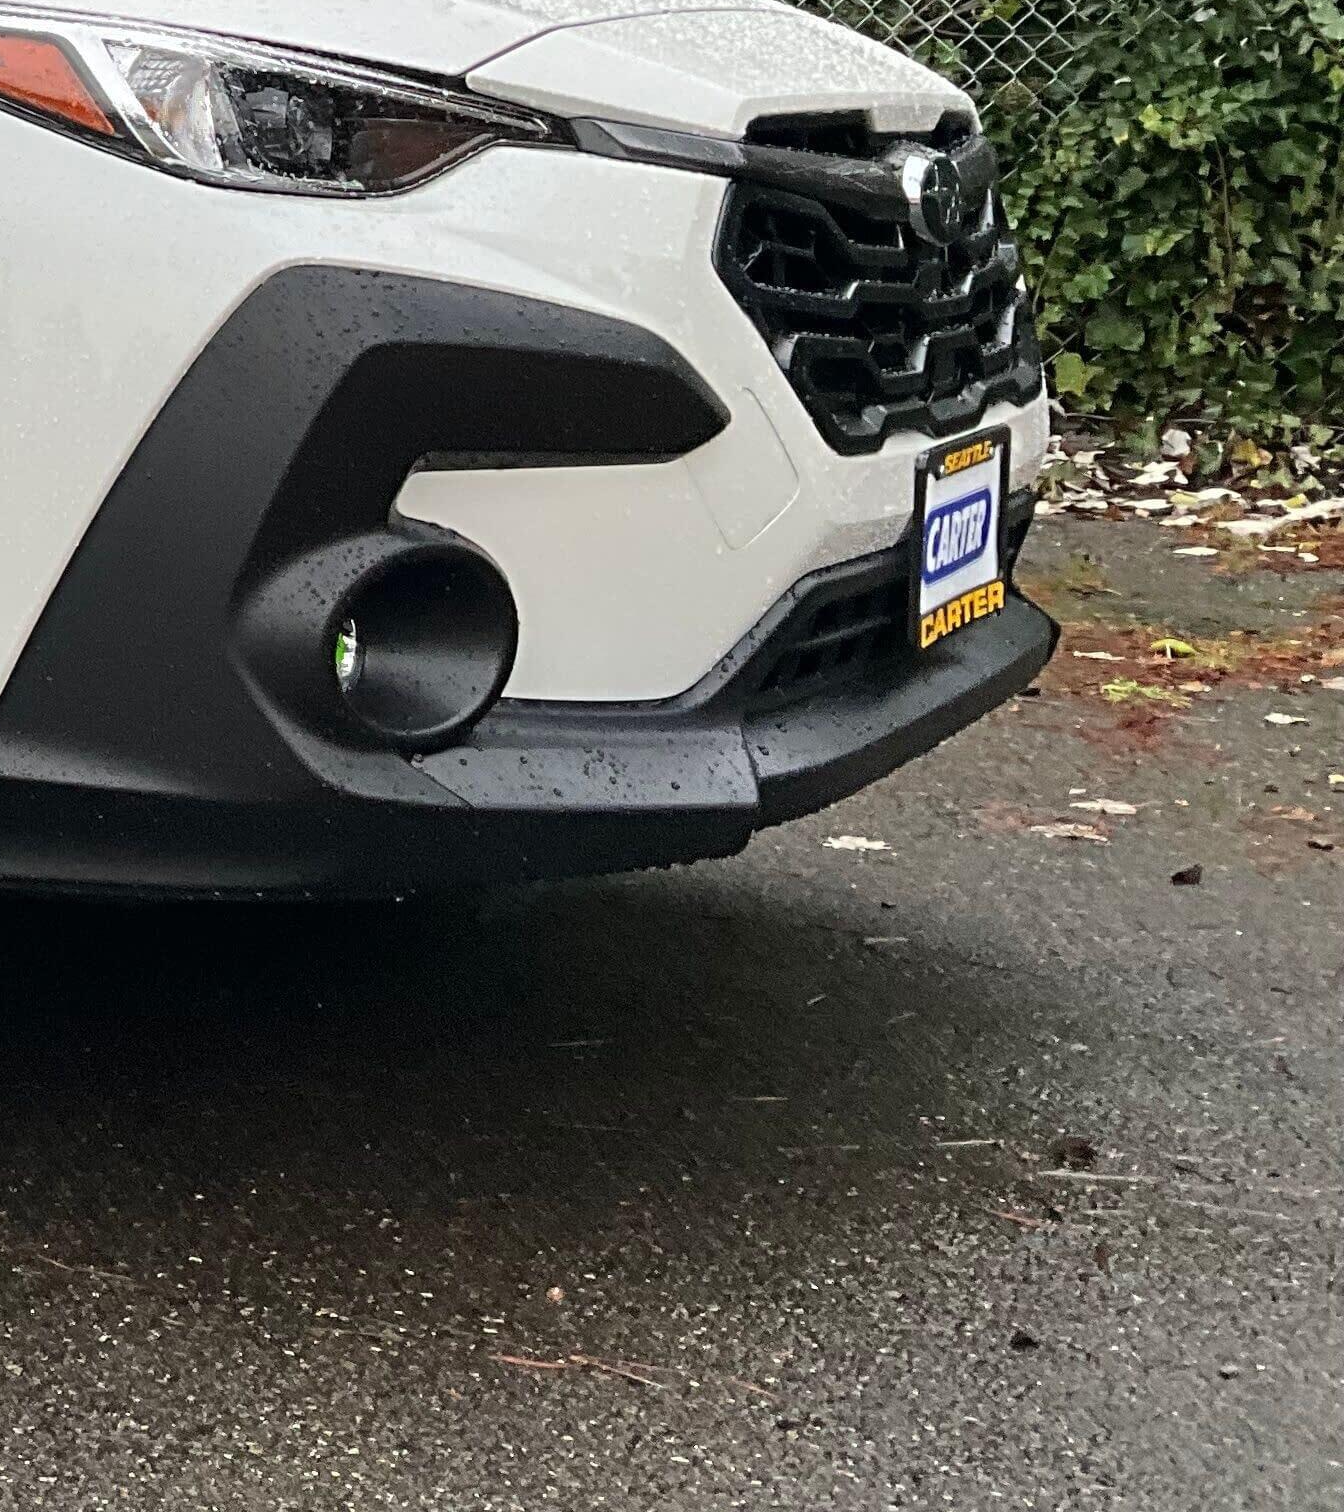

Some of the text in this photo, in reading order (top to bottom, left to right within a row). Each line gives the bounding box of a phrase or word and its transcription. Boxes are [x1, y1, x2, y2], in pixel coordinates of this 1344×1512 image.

[945, 440, 992, 474] SEATTLE
[926, 499, 986, 573] CARTER
[920, 581, 1004, 648] CARTER
